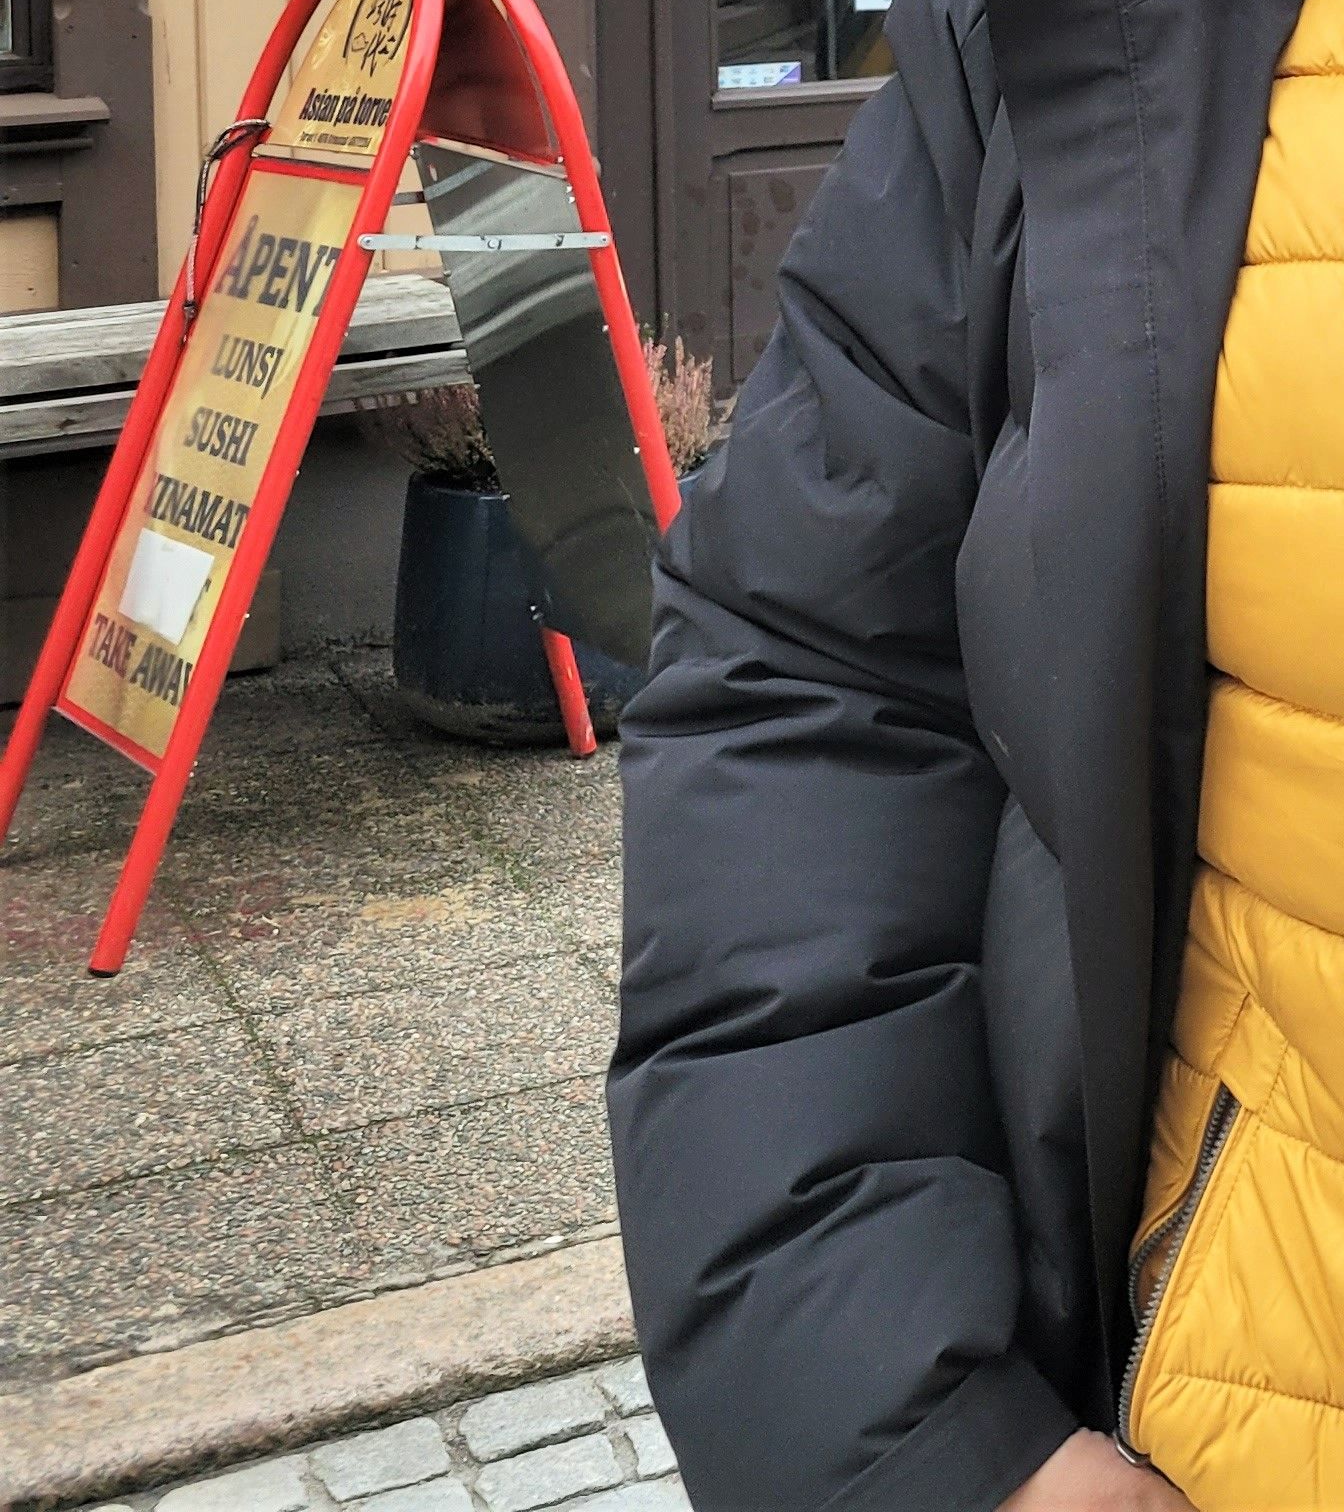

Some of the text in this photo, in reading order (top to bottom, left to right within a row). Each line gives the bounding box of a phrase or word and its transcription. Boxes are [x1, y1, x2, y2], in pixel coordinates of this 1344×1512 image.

[352, 93, 393, 128] torve
[183, 406, 259, 467] SUSHI
[88, 612, 138, 680] TAKE
